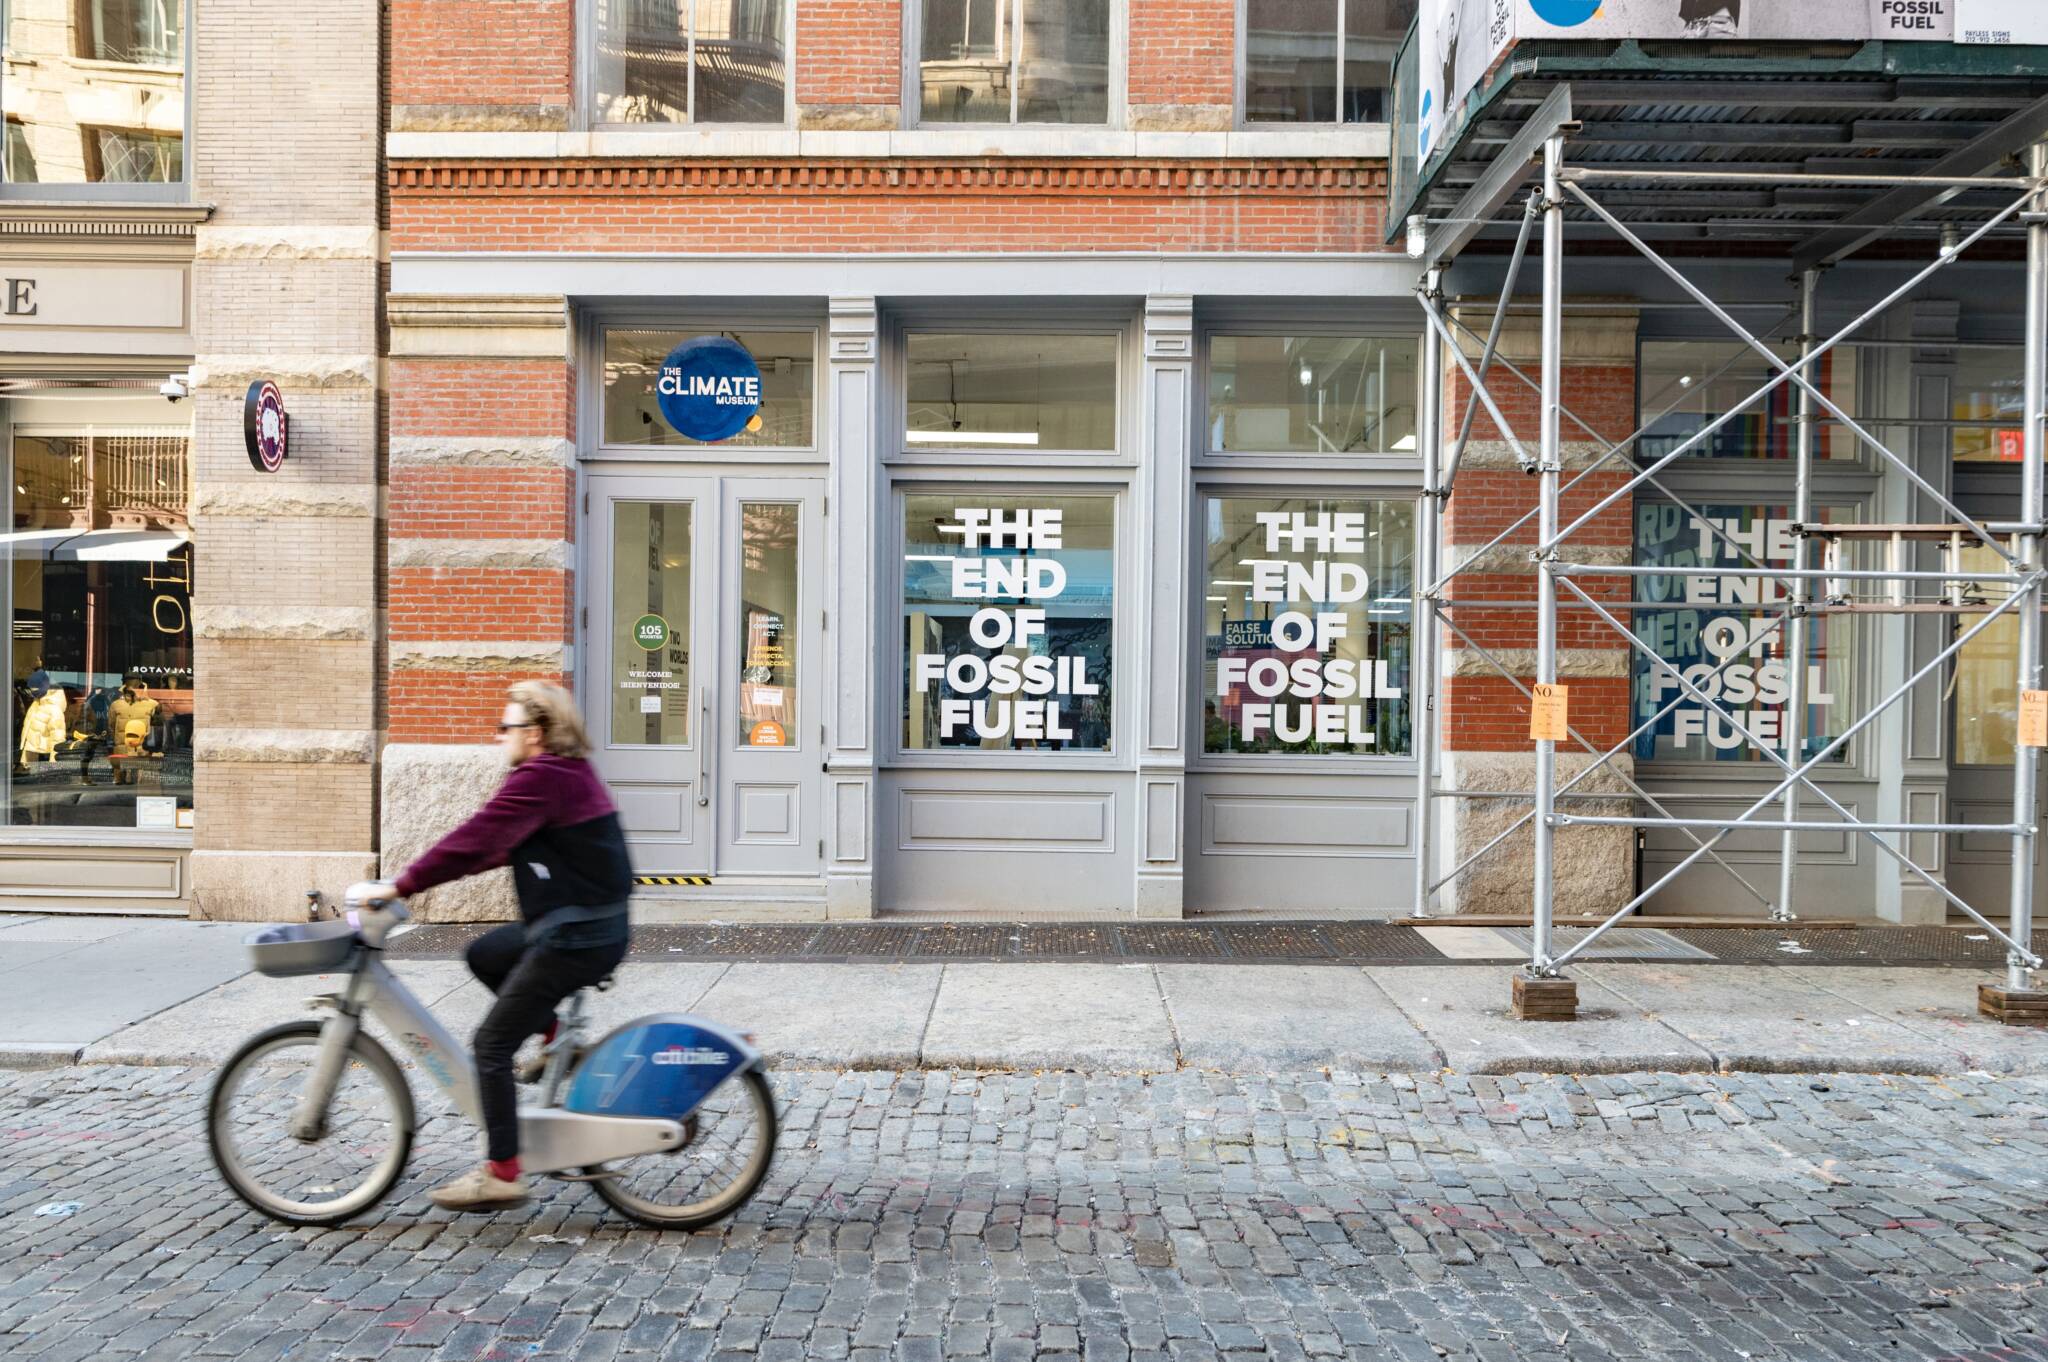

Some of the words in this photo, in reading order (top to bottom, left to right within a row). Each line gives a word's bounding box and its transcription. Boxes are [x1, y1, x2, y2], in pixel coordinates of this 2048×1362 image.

[1882, 1, 1944, 14] FOSSIL
[1891, 16, 1935, 29] FUEL
[658, 376, 759, 396] CLIMATE
[663, 367, 682, 376] THE
[716, 396, 758, 405] MUSEUM
[955, 508, 1062, 549] THE
[1256, 512, 1365, 553] THE
[1689, 518, 1796, 560] THE
[952, 558, 1067, 599] END
[1253, 562, 1369, 603] END
[640, 625, 662, 635] 105
[669, 630, 681, 646] TWO
[969, 607, 1046, 649] OF
[1225, 633, 1292, 645] SOLUTIOS
[1226, 623, 1261, 634] FALSE
[1271, 611, 1348, 652] OF
[1703, 616, 1781, 658] OF
[669, 648, 689, 665] WORLDS
[916, 654, 1099, 695] FOSSIL
[1217, 657, 1401, 698] FOSSIL
[1535, 686, 1552, 698] NO
[1650, 664, 1834, 705] FOSSL
[940, 700, 1073, 740] FUEL
[1241, 703, 1375, 743] FUEL
